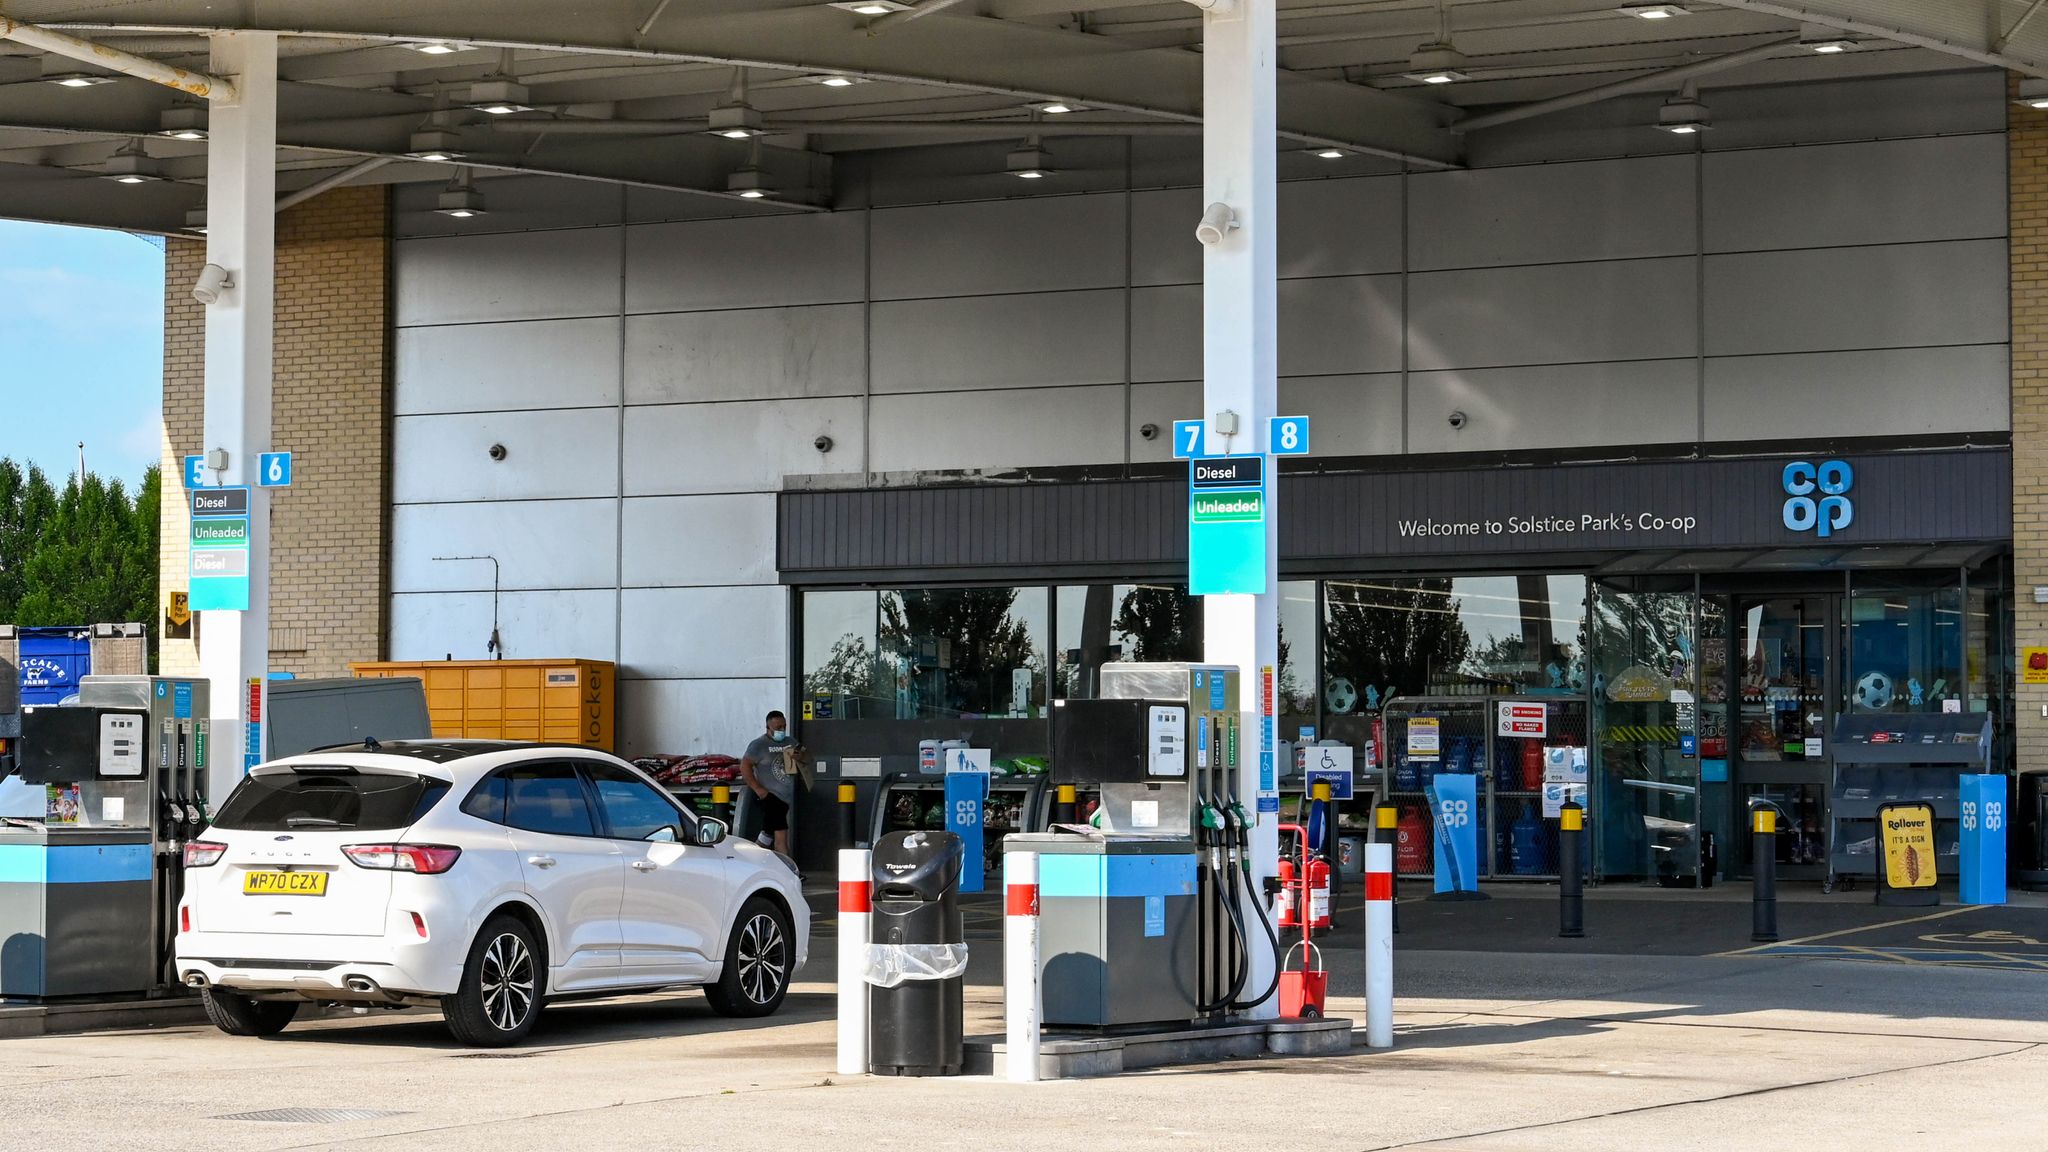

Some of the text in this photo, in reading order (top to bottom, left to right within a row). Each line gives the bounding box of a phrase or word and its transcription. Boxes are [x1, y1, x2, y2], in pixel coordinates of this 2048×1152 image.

[1184, 425, 1200, 453] 7
[1280, 421, 1298, 450] 8
[192, 460, 204, 484] 5
[268, 456, 282, 482] 6
[1196, 464, 1236, 480] Diesel
[195, 495, 227, 509] Diesel
[1196, 498, 1259, 514] Unleaded
[194, 525, 245, 539] Unleaded
[1398, 511, 1696, 537] Welcome to Solstice Park's Co-op
[194, 557, 226, 570] Diesel
[1195, 672, 1202, 687] 8
[158, 683, 165, 696] 6
[585, 664, 601, 743] locker
[1888, 818, 1926, 831] Rollover
[1892, 835, 1925, 845] IT'S A SIGN
[290, 874, 319, 890] CZX
